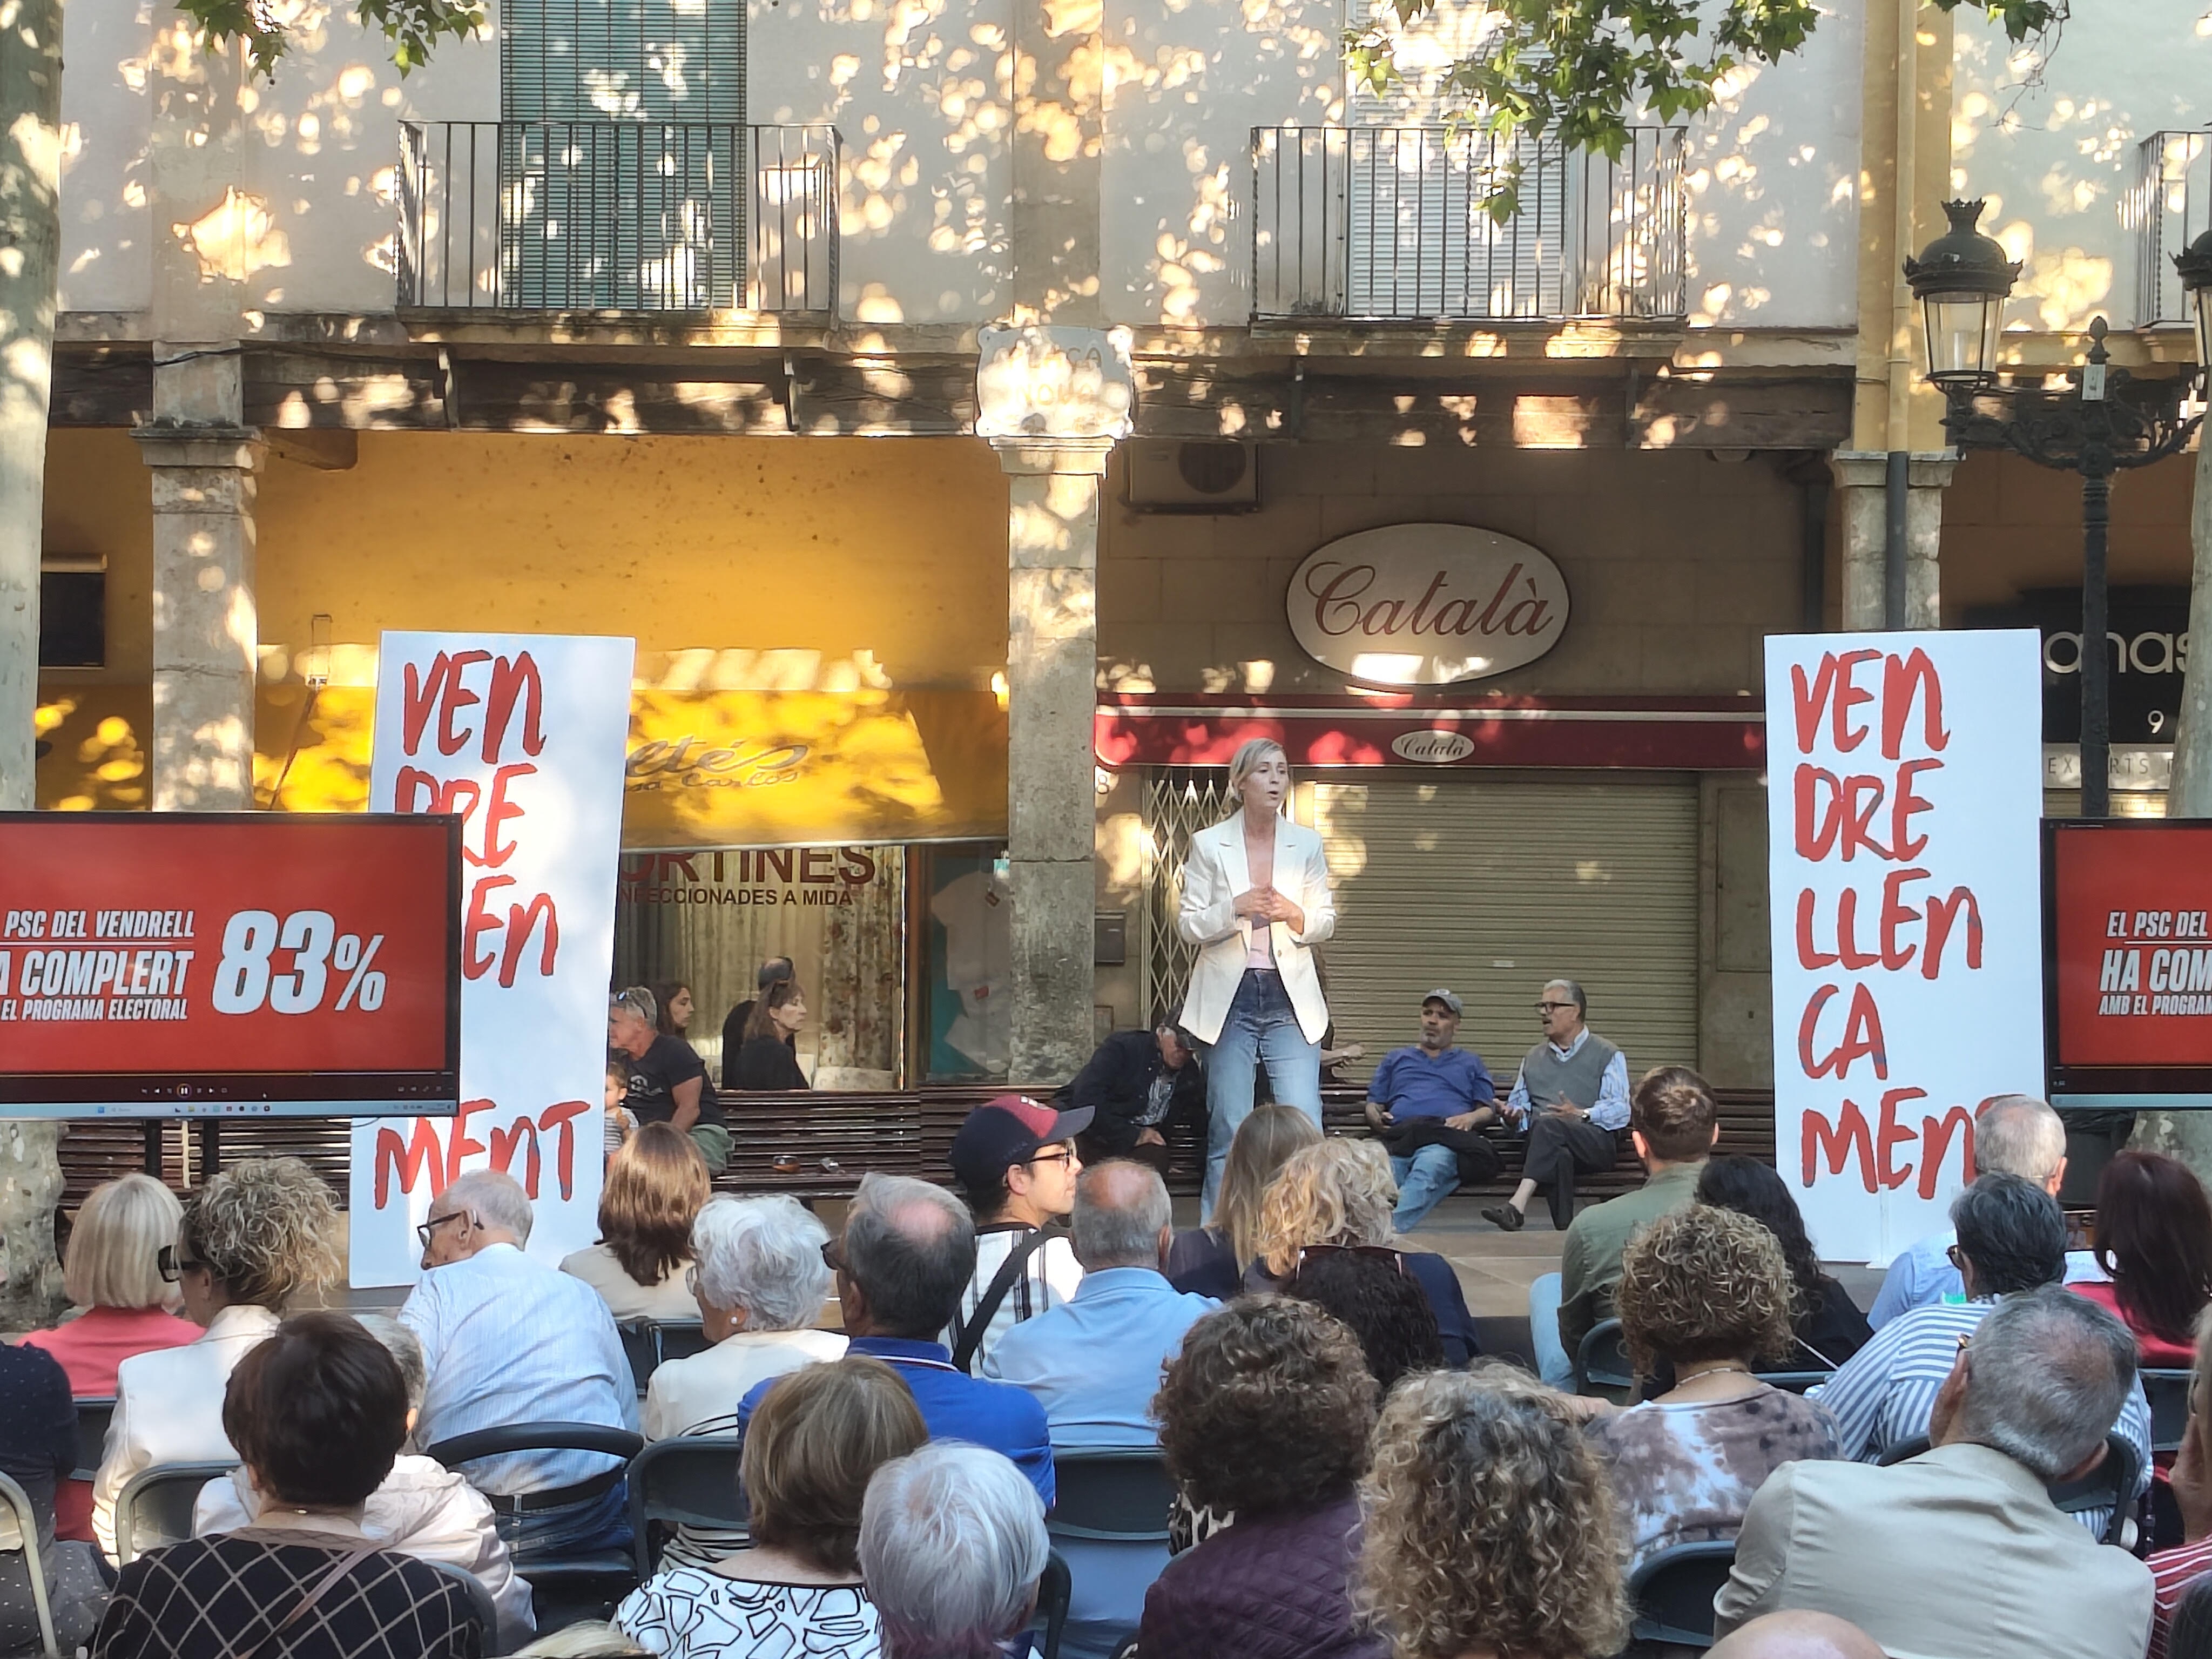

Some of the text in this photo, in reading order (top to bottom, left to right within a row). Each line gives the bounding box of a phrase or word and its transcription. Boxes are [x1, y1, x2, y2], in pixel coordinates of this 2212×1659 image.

[1305, 561, 1554, 636] Català
[2147, 710, 2164, 734] 9
[2048, 757, 2148, 774] EXRTS
[1794, 758, 1945, 862] DRE
[783, 890, 797, 905] A
[802, 890, 853, 906] MIDA
[4, 910, 194, 938] PSC DEL VENDRELL
[2107, 911, 2208, 938] EL PSC DEL
[20, 950, 195, 996] COMPLERT
[212, 909, 387, 1014] 83%
[2099, 949, 2141, 992] HA
[1, 999, 188, 1021] EL PROGRAMA ELECTORAL
[2098, 995, 2130, 1015] AMB
[2133, 995, 2148, 1015] EL
[1798, 982, 1889, 1080] CA
[1801, 1087, 2026, 1201] MEN
